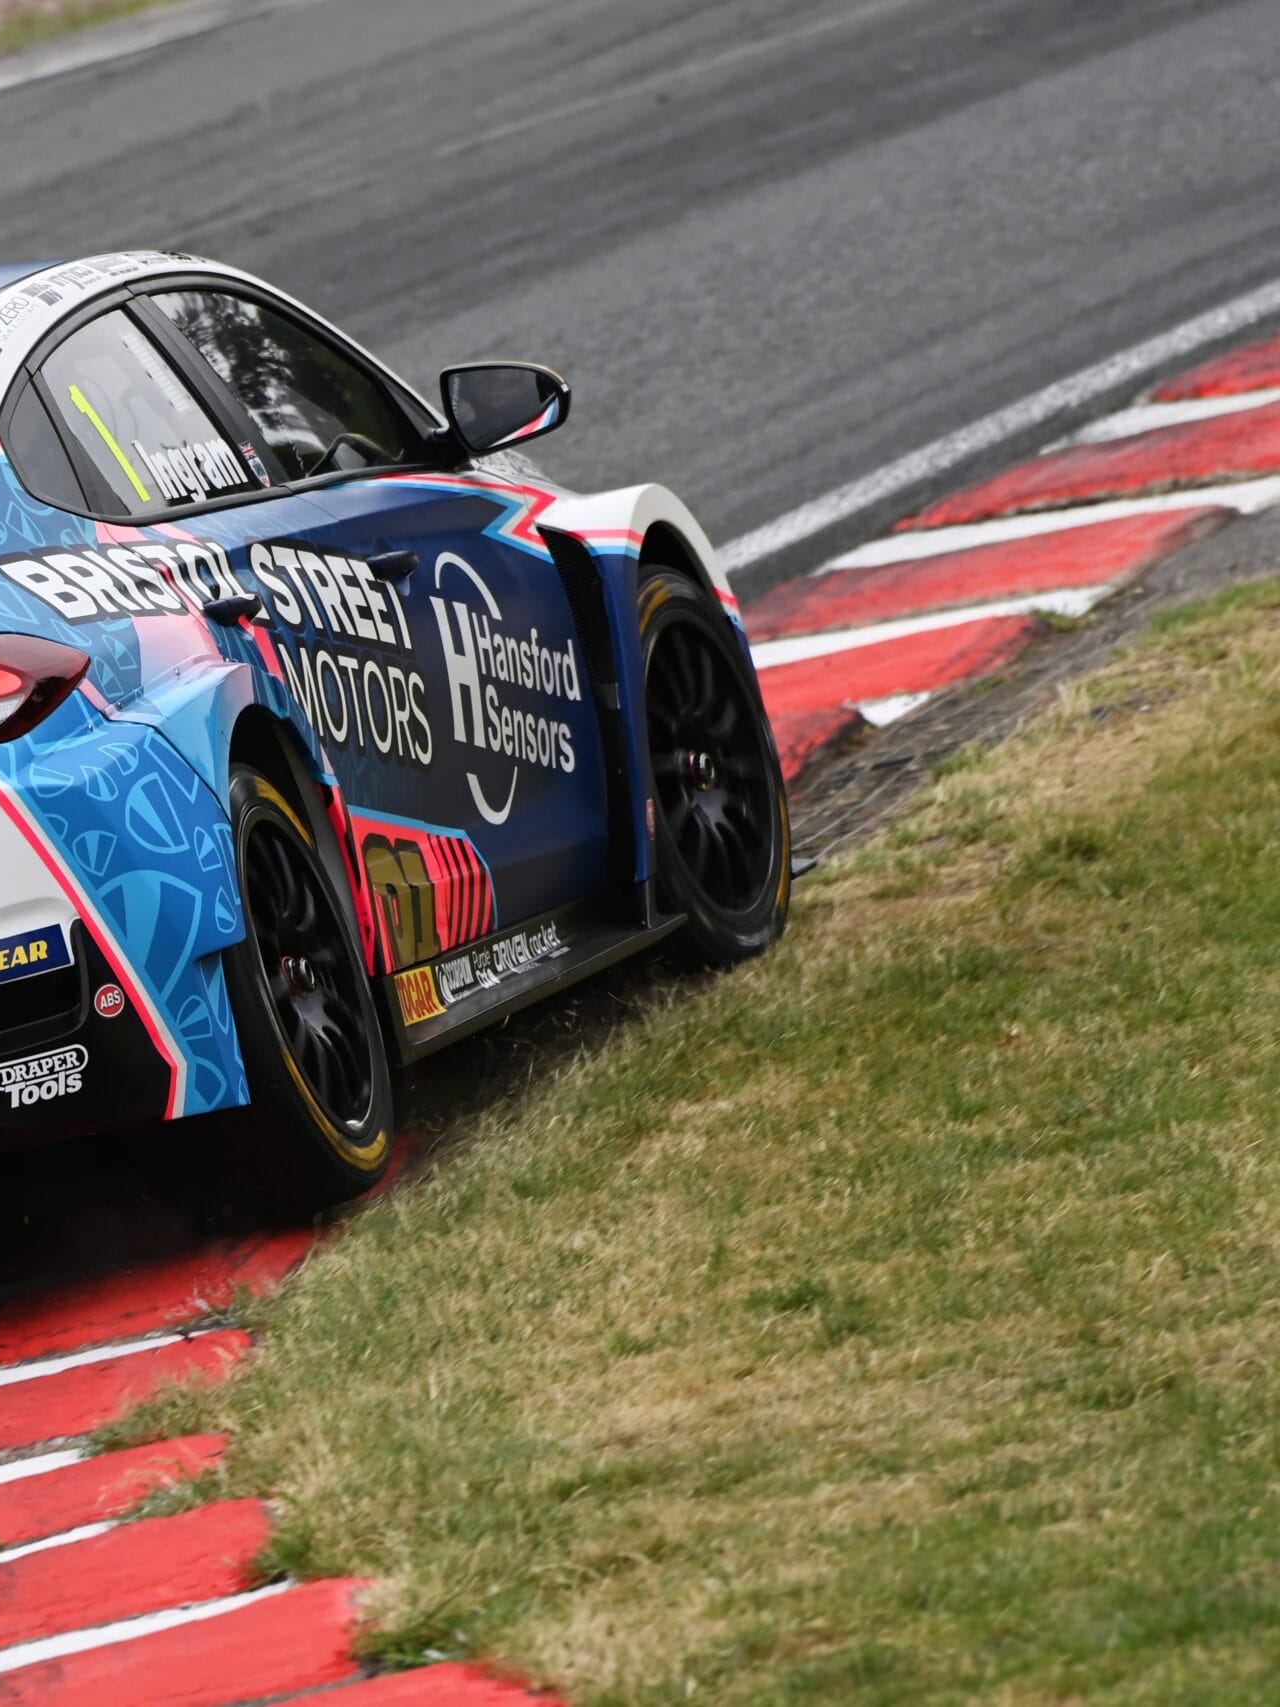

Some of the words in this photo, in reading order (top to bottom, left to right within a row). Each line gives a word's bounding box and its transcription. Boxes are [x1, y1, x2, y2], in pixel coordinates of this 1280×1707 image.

[68, 384, 150, 502] 1
[131, 437, 248, 502] Ingram
[0, 542, 271, 619] BRISTOL
[472, 610, 582, 702] Hansford
[277, 642, 433, 766] MOTORS
[485, 687, 576, 775] Sensors
[99, 990, 121, 1011] ABS
[0, 1050, 80, 1087] DRAPER
